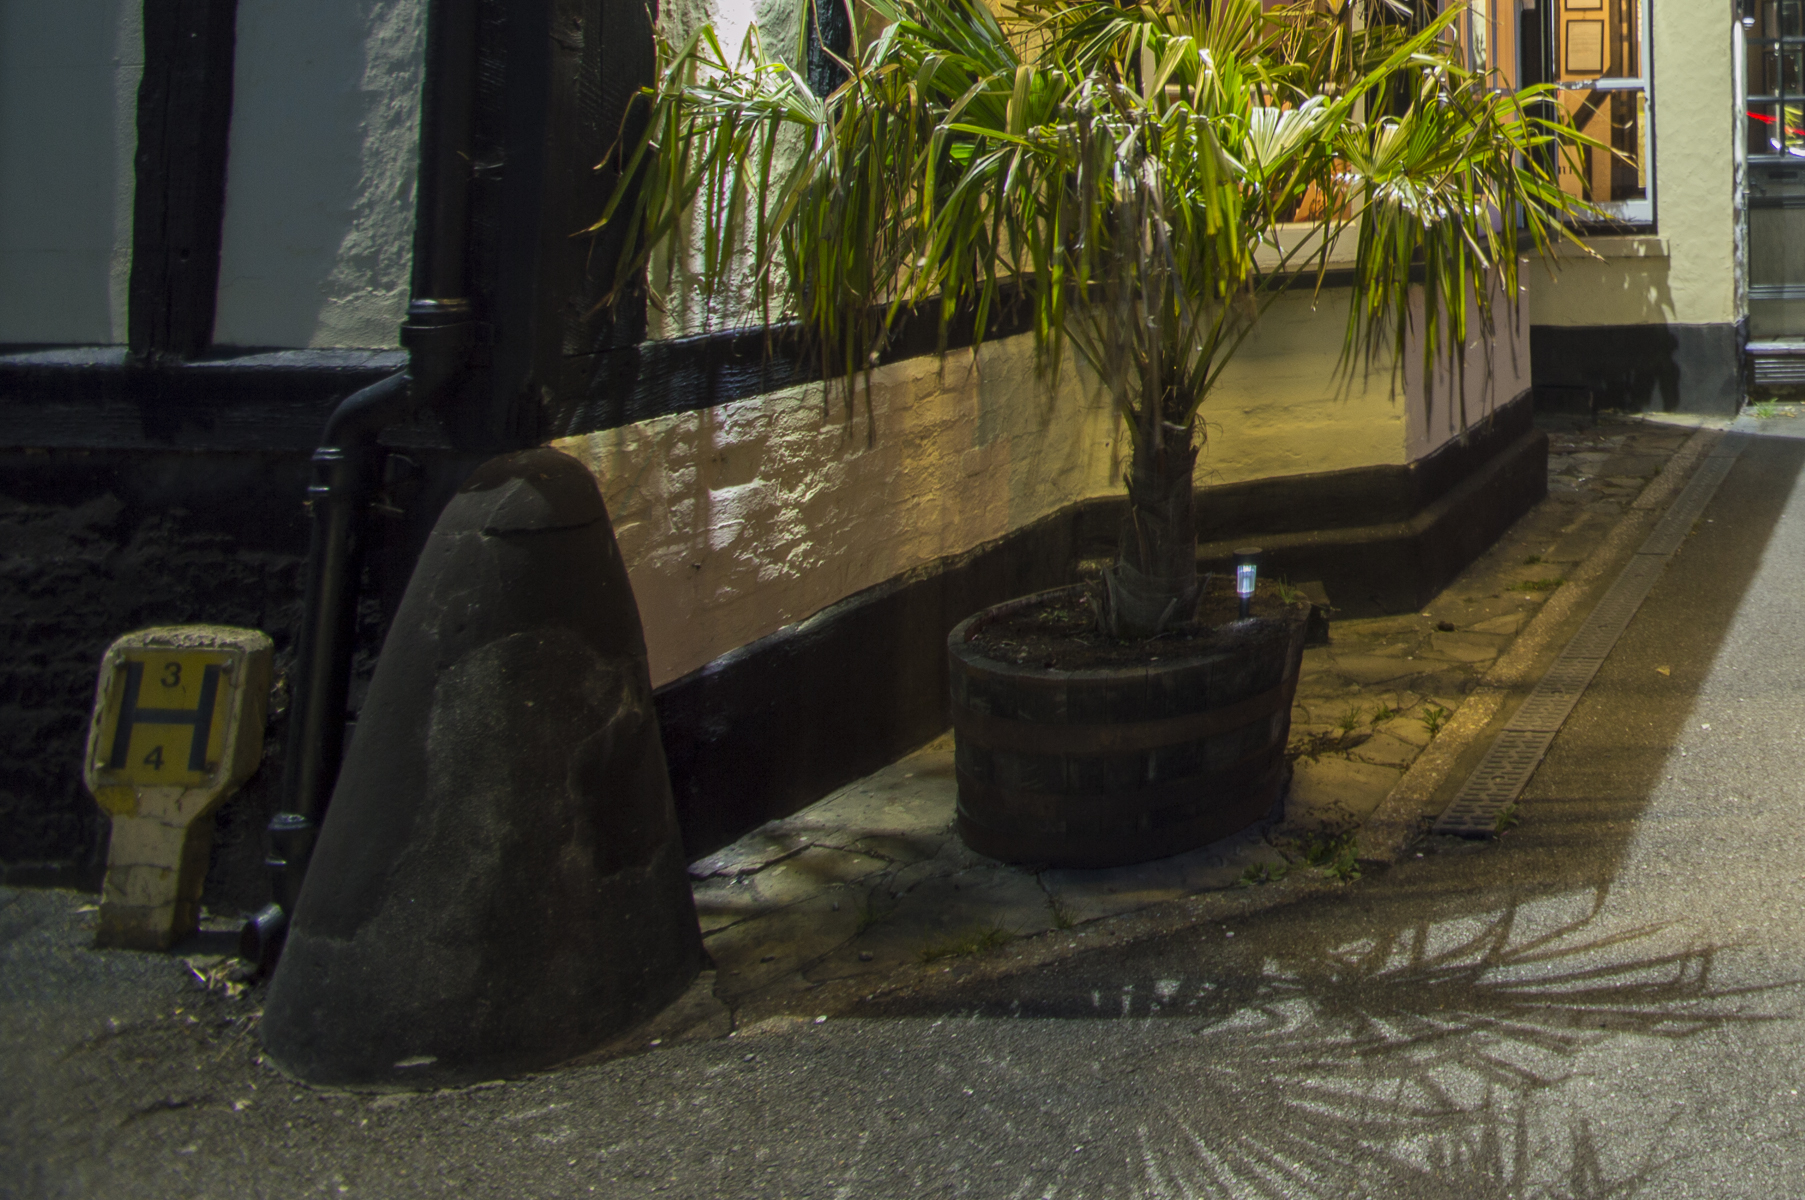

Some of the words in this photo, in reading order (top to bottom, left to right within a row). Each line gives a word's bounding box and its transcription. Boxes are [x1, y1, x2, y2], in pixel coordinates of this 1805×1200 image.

[161, 661, 182, 688] 3
[110, 661, 221, 771] H
[143, 745, 165, 771] 4
